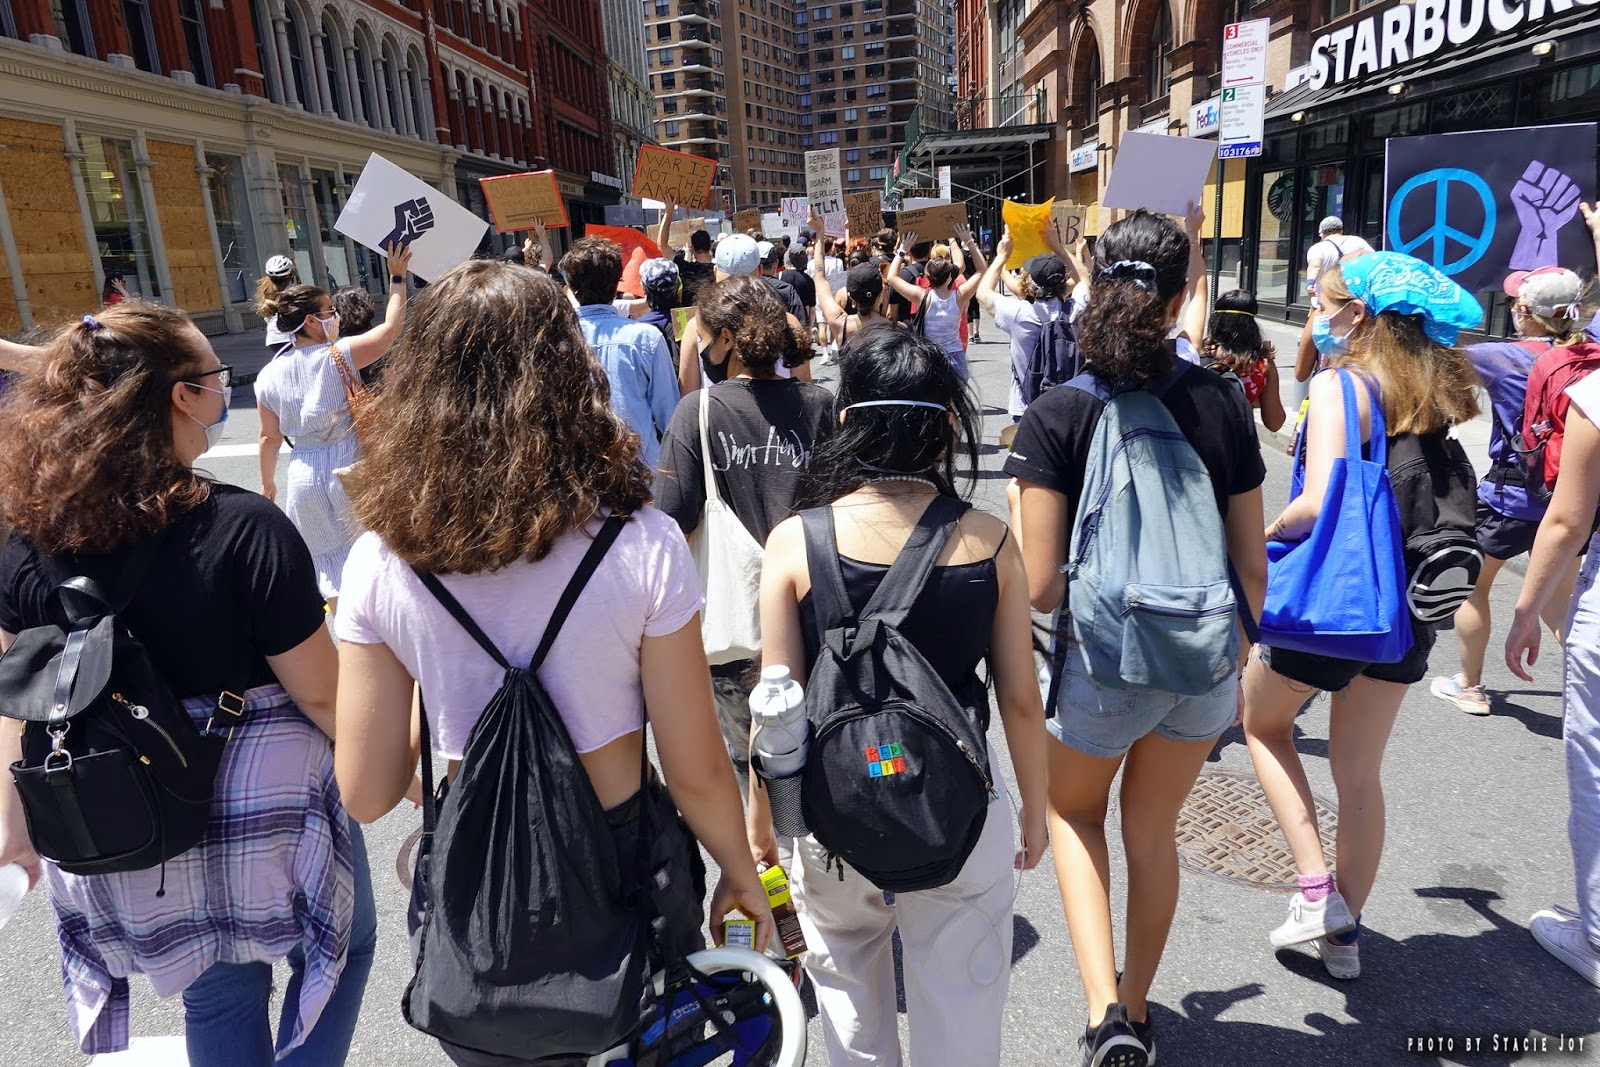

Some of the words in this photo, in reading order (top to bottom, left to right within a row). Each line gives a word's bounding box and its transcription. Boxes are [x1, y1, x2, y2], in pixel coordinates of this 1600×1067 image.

[1227, 26, 1236, 39] 3
[1226, 40, 1258, 50] COMMERCIAL
[1309, 0, 1600, 90] STARBUC
[1226, 48, 1249, 57] VEHICLES
[1225, 89, 1233, 102] 2
[1196, 104, 1218, 130] FedEx
[1220, 147, 1251, 157] 103176
[645, 151, 681, 172] WAR
[688, 160, 710, 179] IS
[808, 153, 833, 165] DEFUND
[808, 165, 819, 173] THE
[820, 161, 836, 171] POLICE
[640, 166, 671, 184] NOT
[677, 174, 706, 194] THE
[809, 177, 832, 188] DISARM
[809, 191, 819, 200] THE
[819, 188, 839, 198] POLICE
[782, 198, 799, 214] NO
[810, 198, 840, 215] TLM
[865, 211, 881, 223] LAST
[901, 211, 927, 220] STAPLES
